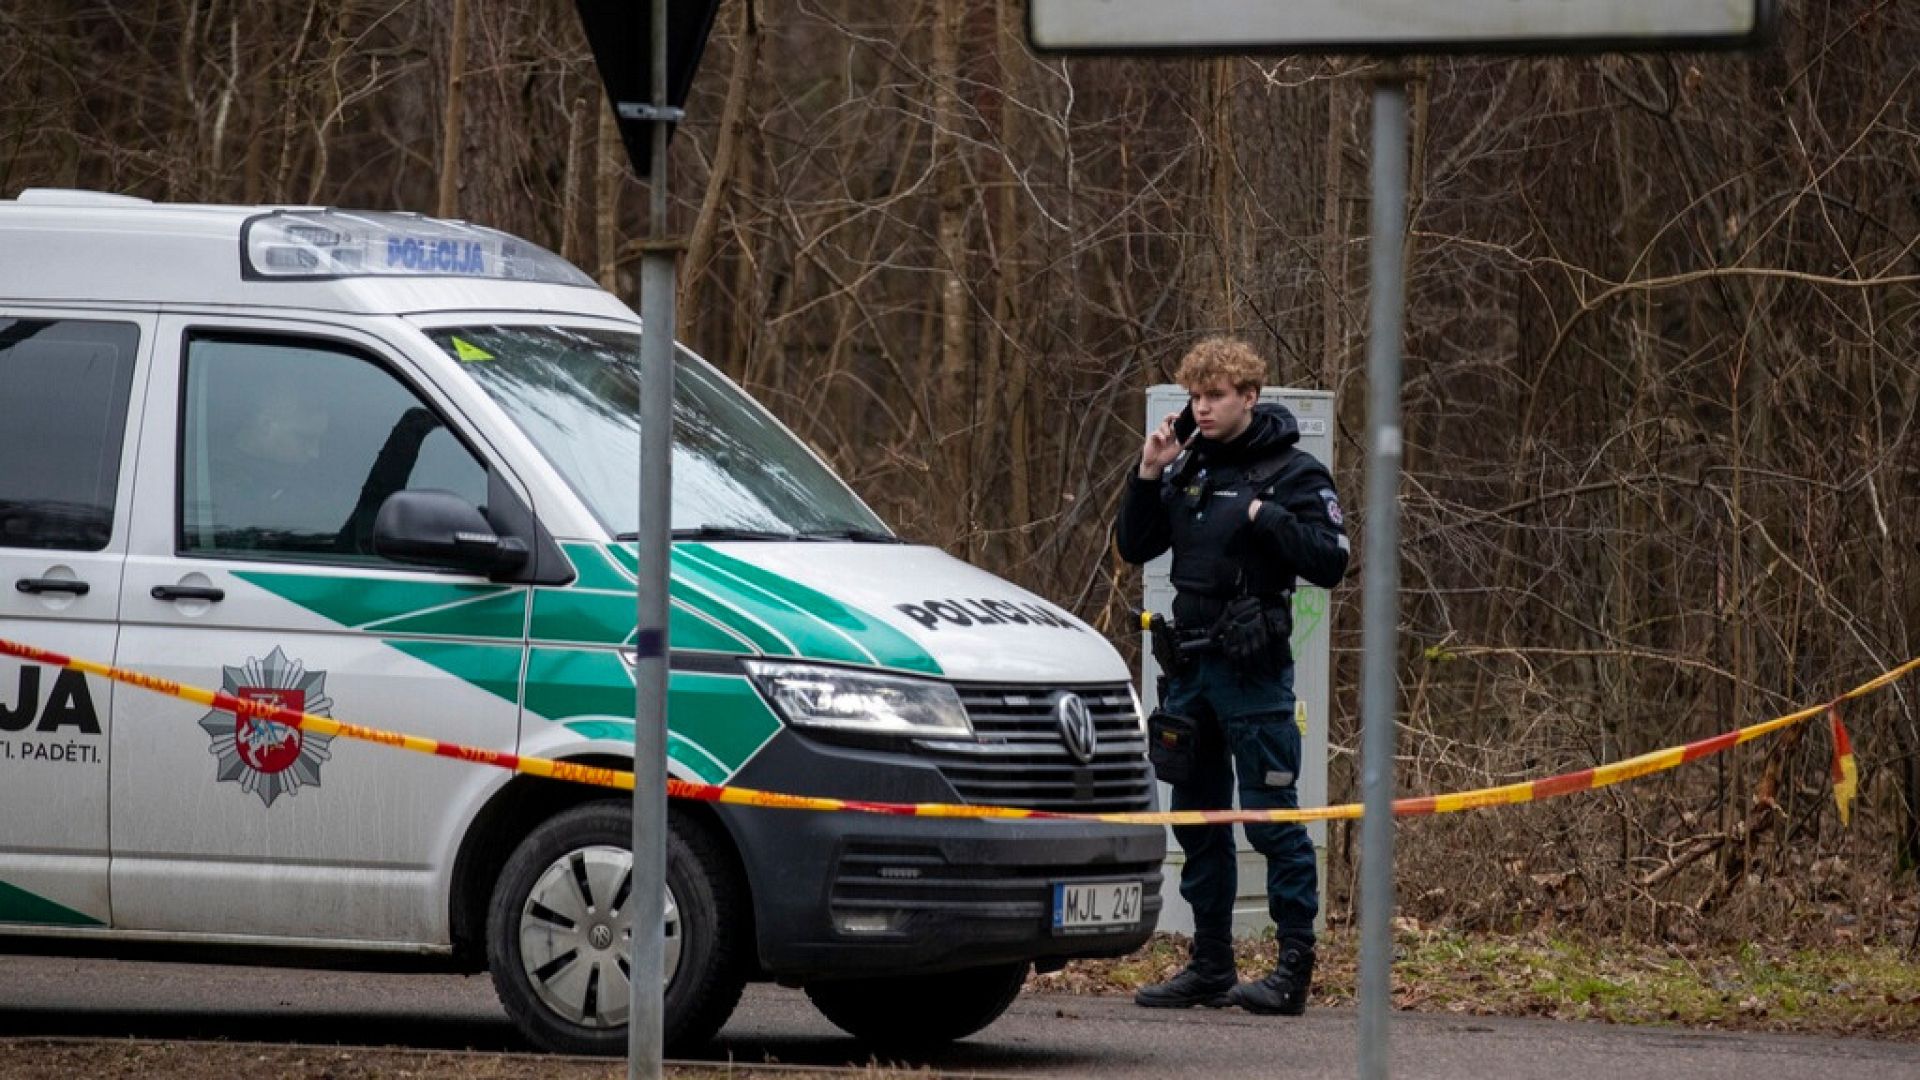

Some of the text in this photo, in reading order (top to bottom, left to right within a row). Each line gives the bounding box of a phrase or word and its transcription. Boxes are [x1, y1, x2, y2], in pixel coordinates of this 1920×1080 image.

[387, 236, 485, 273] POLICIJA
[893, 598, 1084, 633] POLICIJA
[21, 739, 102, 764] PADĖTI.
[1066, 886, 1139, 922] MJL 247
